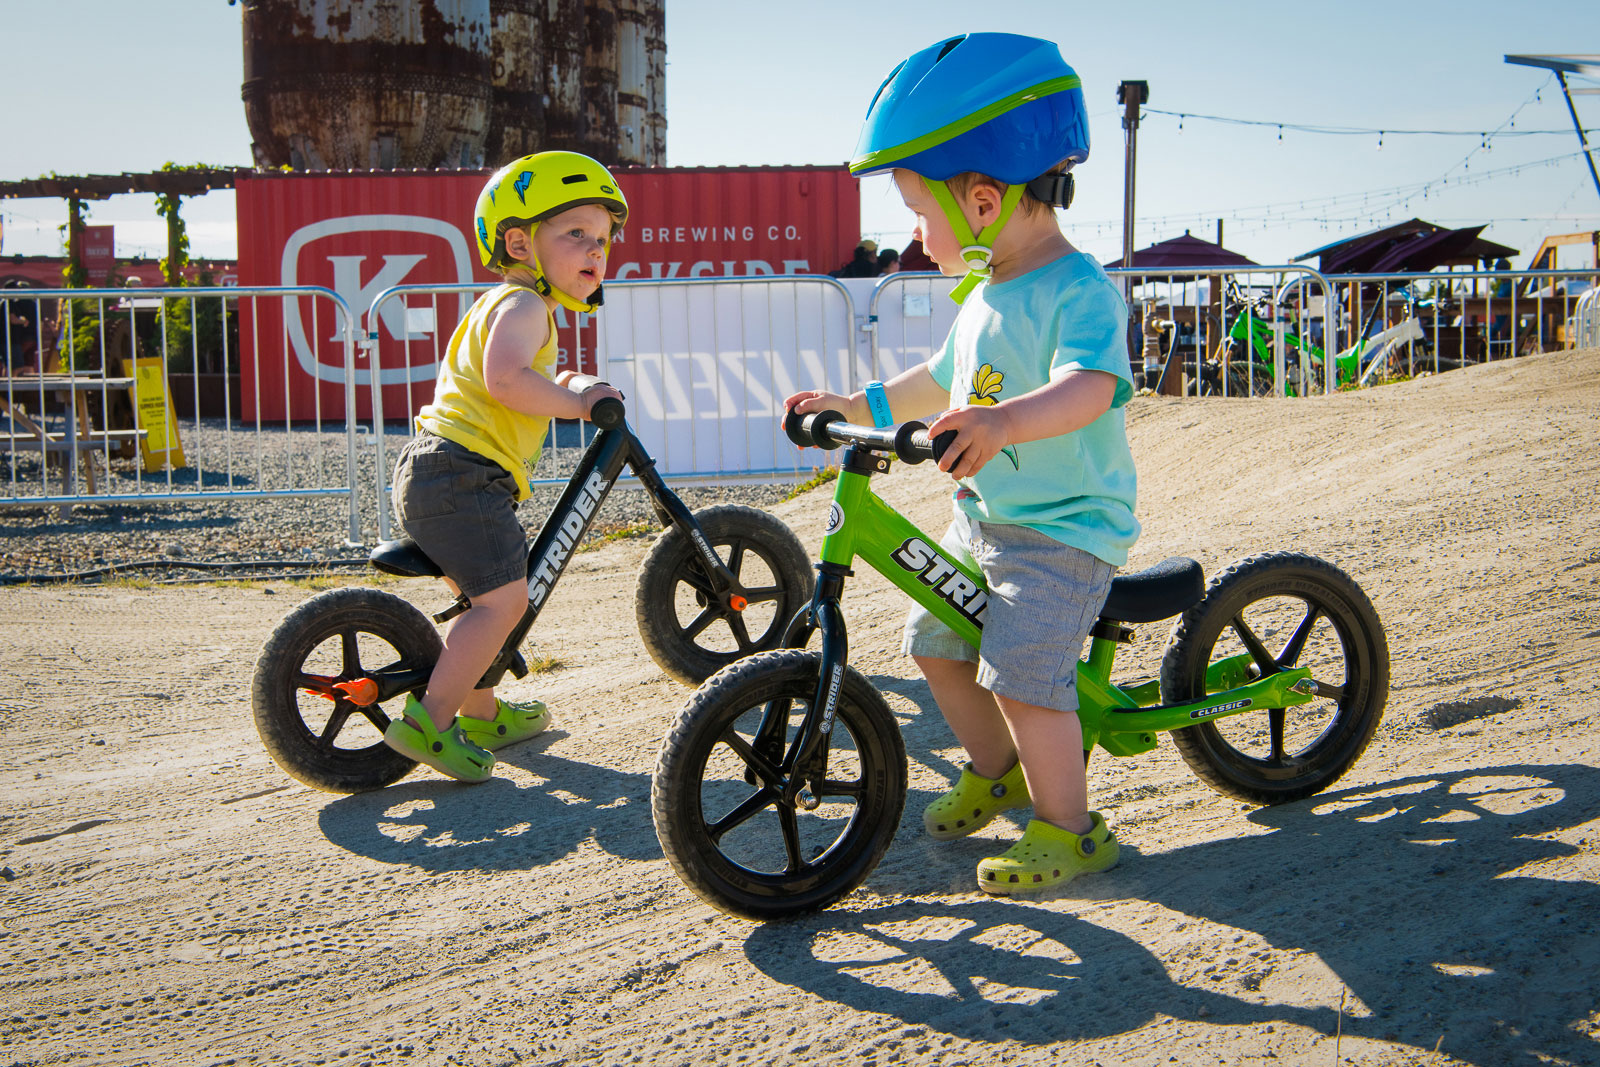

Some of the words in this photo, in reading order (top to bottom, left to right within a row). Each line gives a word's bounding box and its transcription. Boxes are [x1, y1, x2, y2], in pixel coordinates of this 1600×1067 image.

[642, 225, 754, 243] BREWING
[768, 225, 801, 241] CO.
[326, 254, 431, 343] K
[528, 470, 609, 608] STRIDER
[697, 537, 719, 568] STRIDER
[893, 538, 988, 621] STRI
[824, 663, 844, 721] STRIDER
[1198, 701, 1243, 717] CLASSIC
